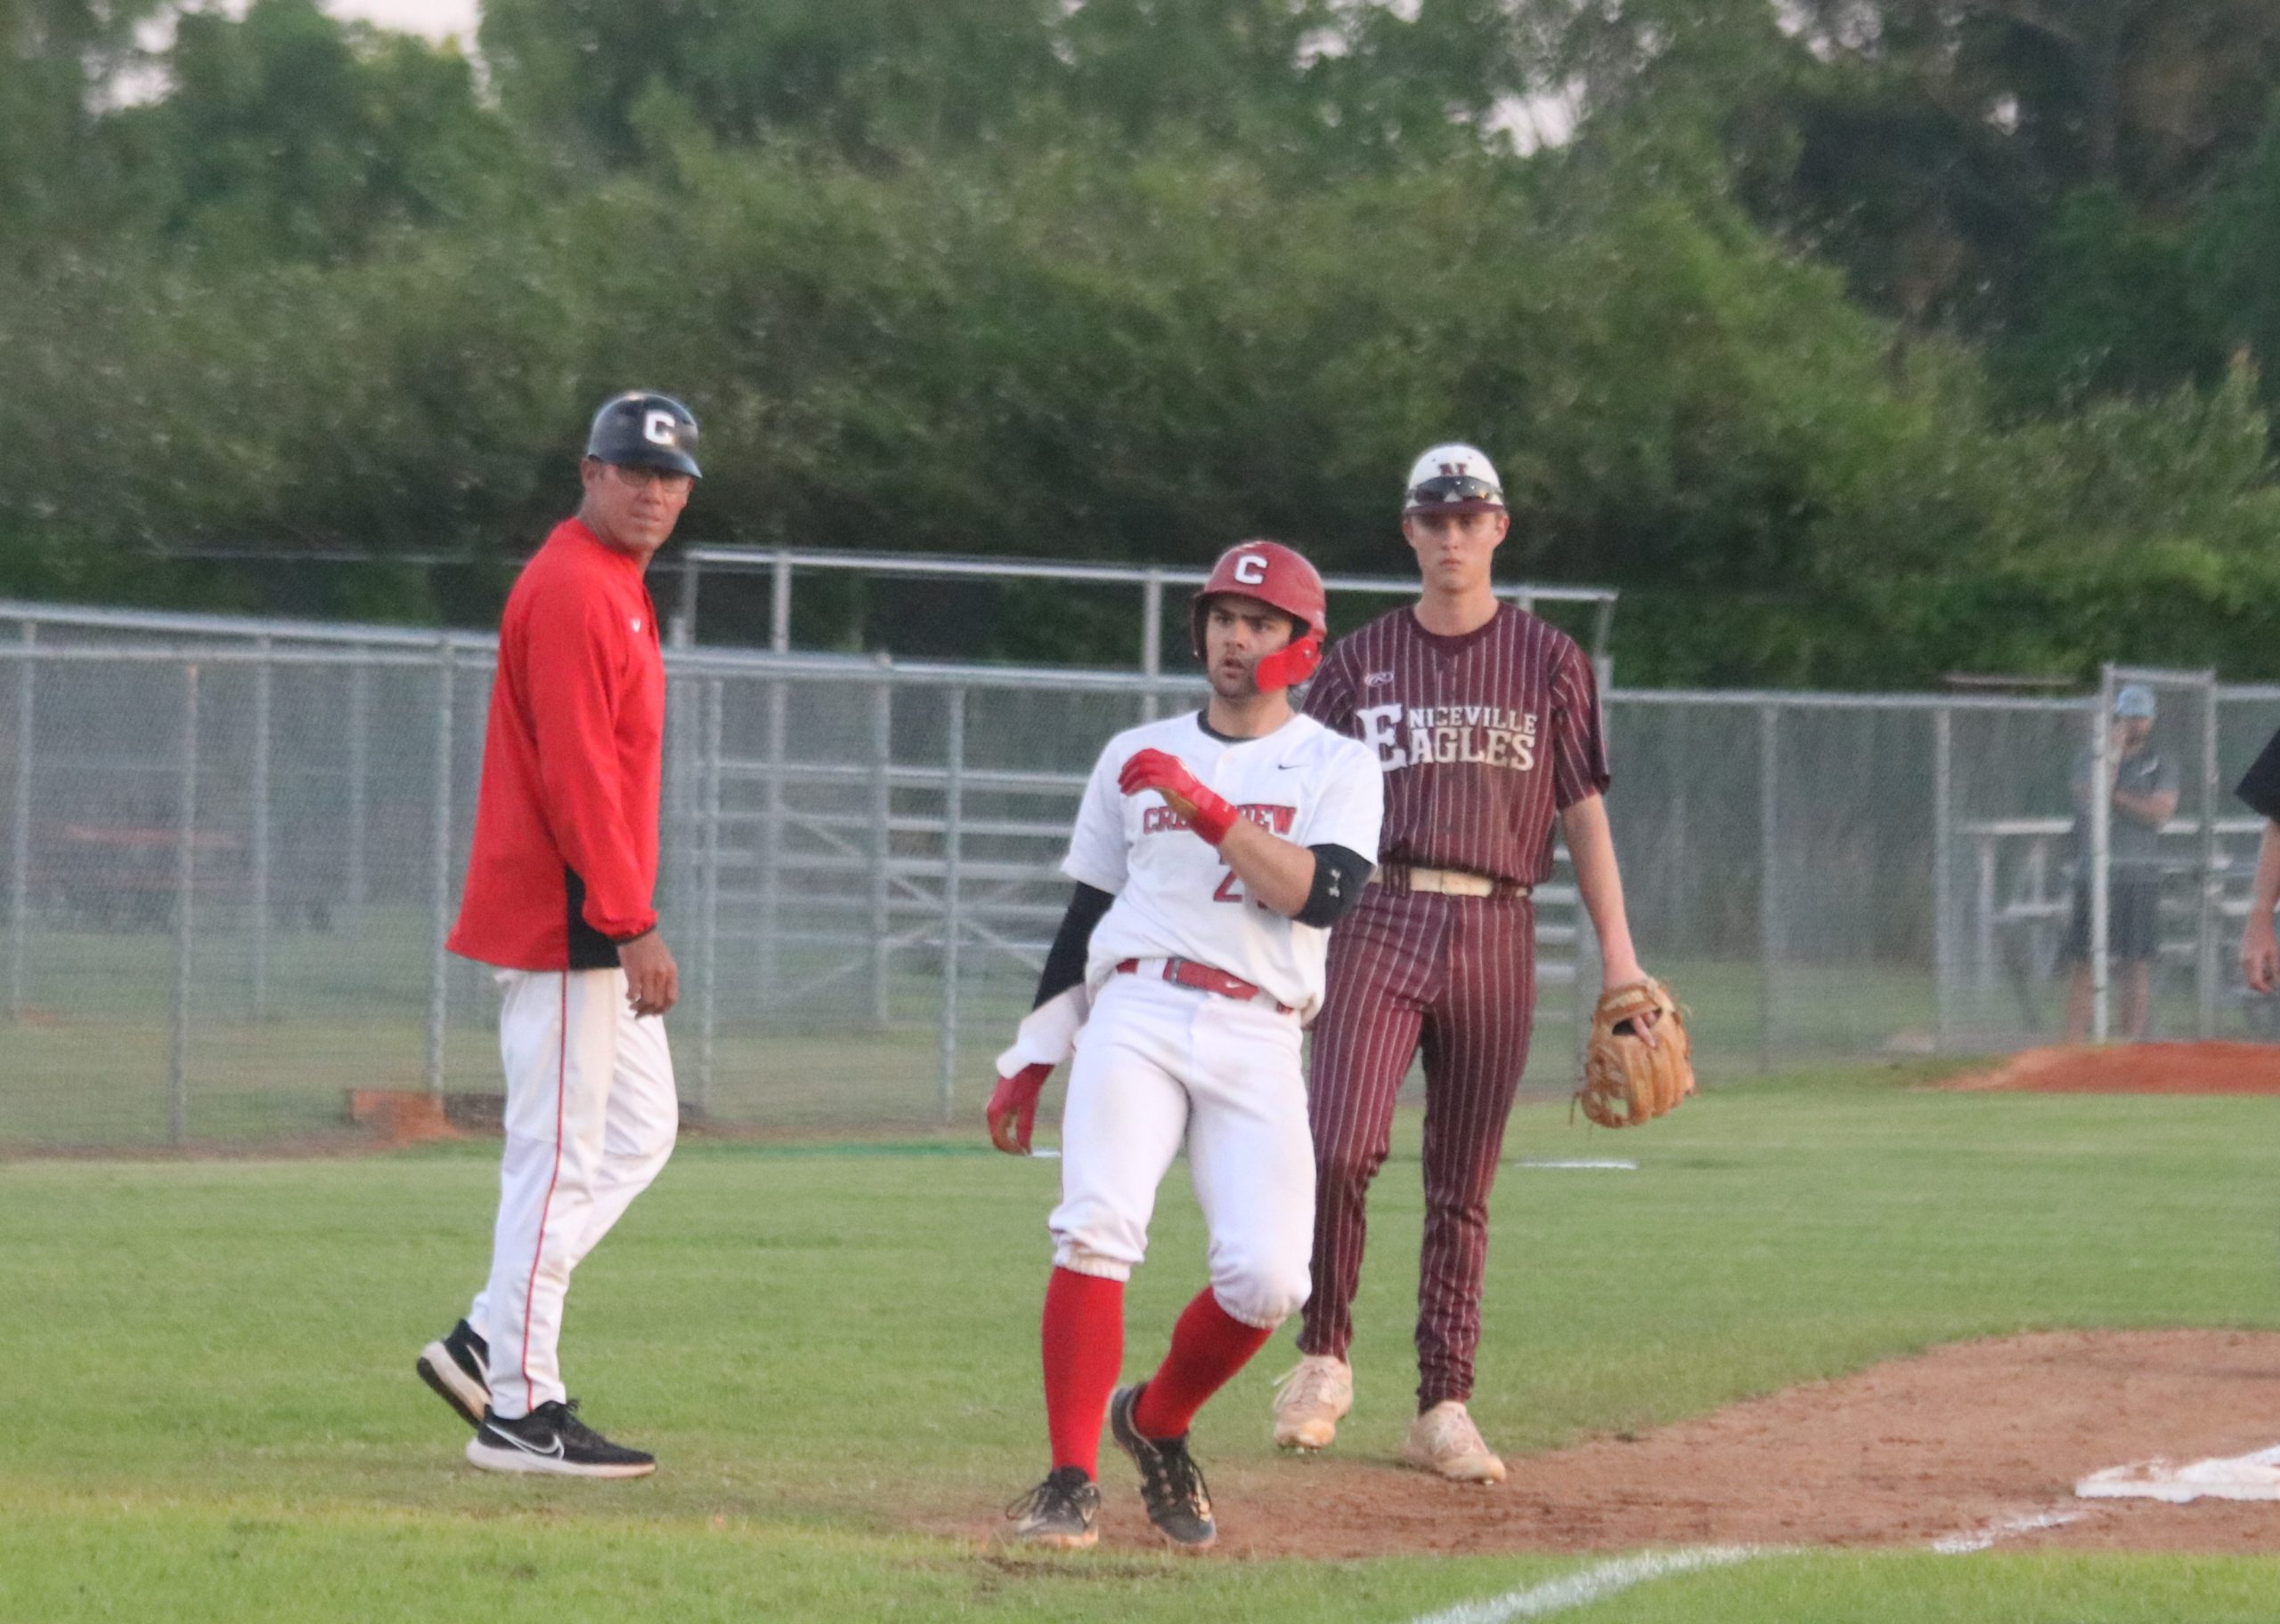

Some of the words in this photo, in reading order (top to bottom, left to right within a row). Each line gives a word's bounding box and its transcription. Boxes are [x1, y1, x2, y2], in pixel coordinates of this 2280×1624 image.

[645, 410, 675, 445] C
[1234, 555, 1267, 584] C
[1409, 705, 1538, 735] NICEVILLE
[1356, 703, 1535, 772] EAGLES
